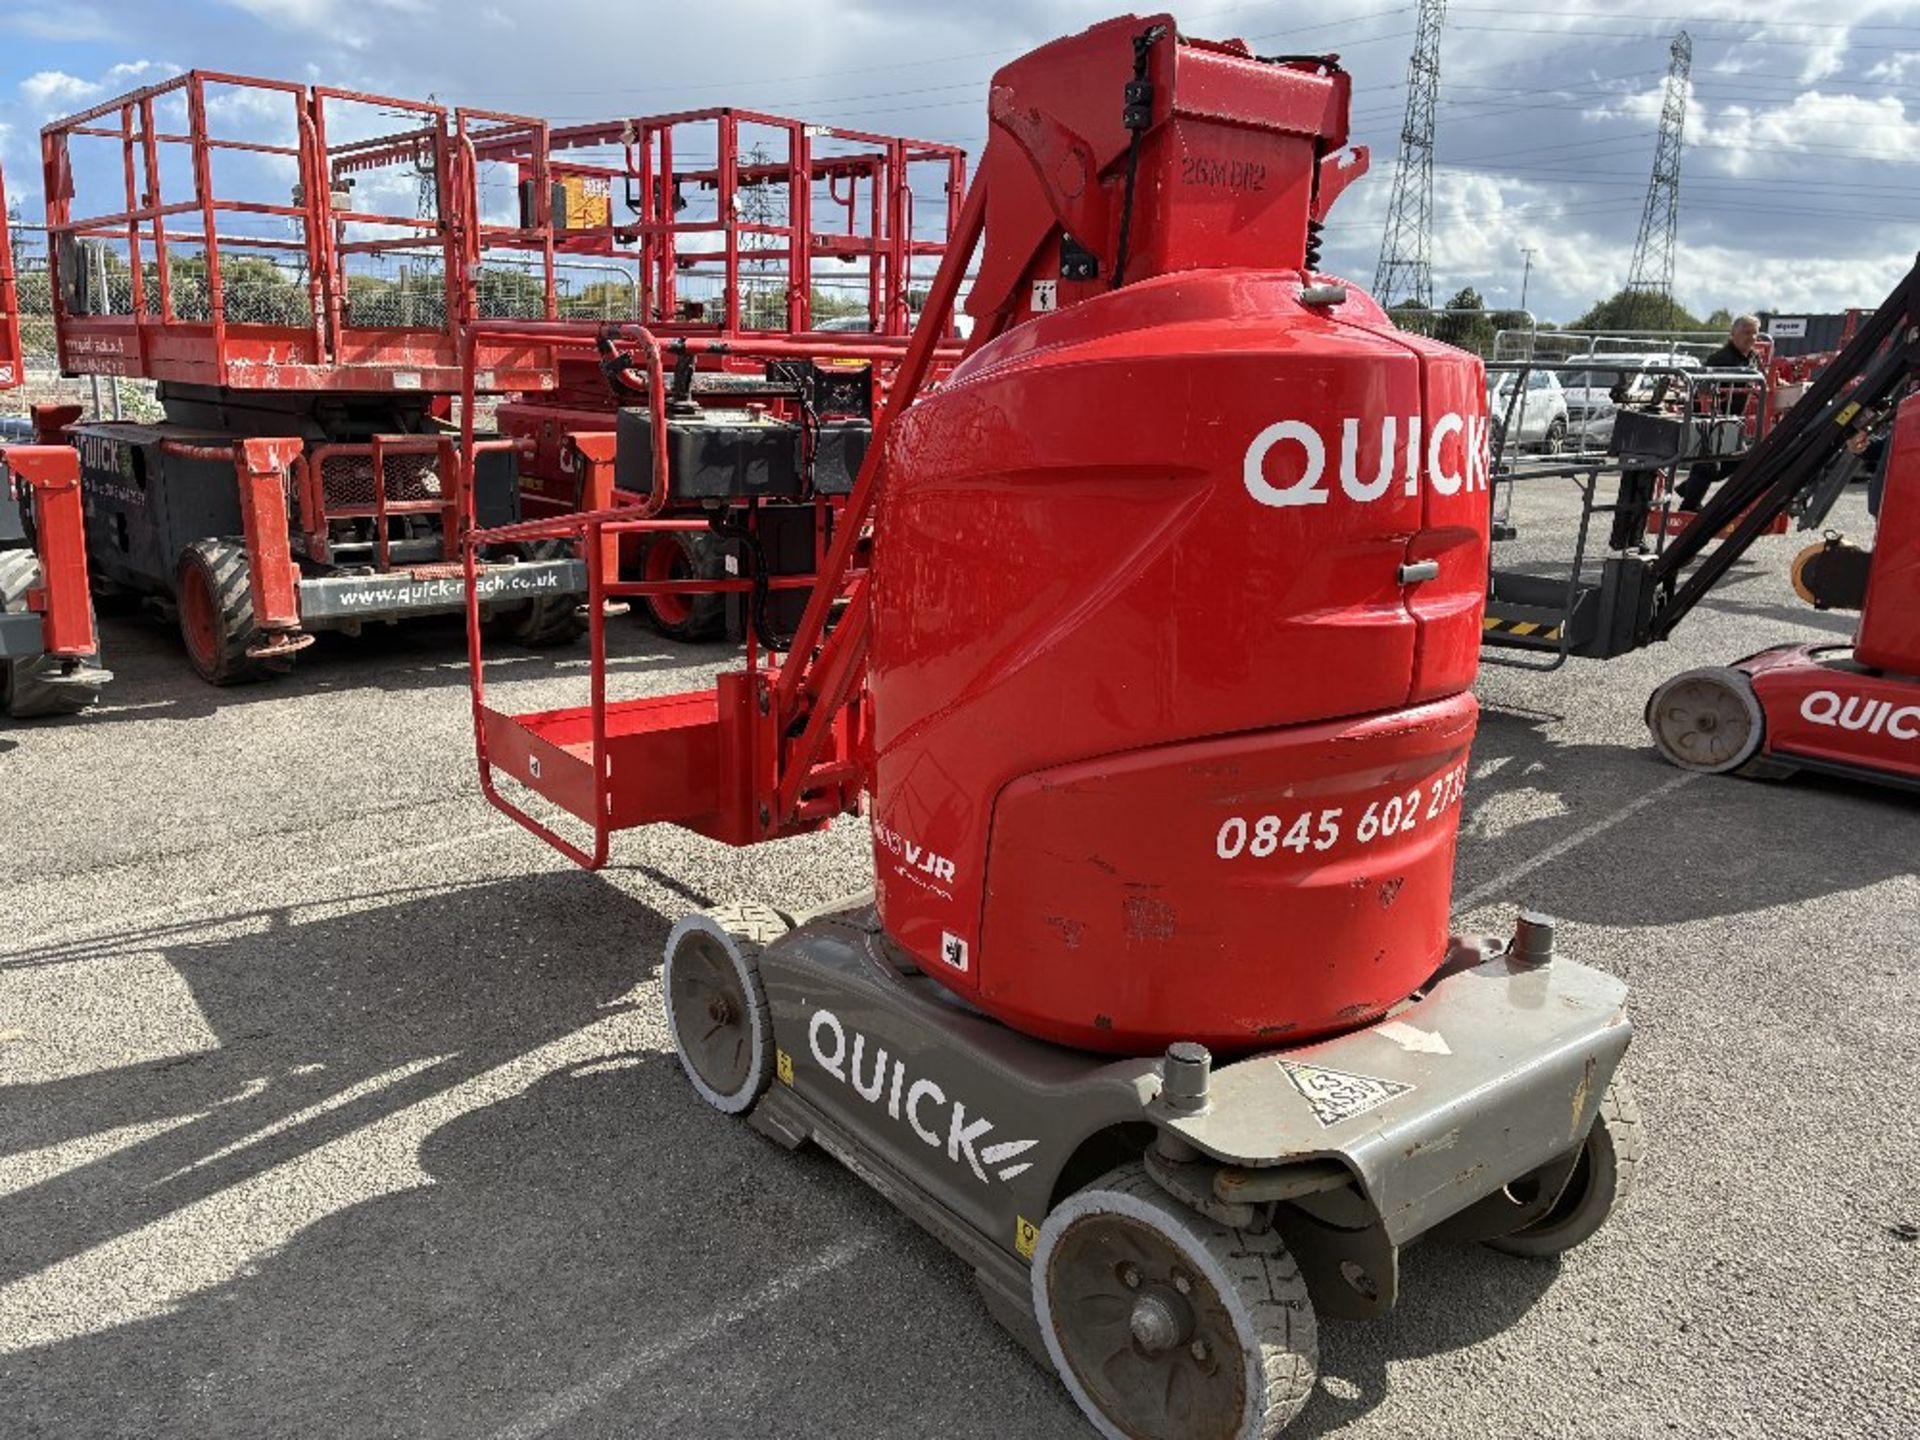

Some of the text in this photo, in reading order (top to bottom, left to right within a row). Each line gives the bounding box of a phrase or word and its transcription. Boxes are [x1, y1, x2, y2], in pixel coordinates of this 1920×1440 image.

[1244, 412, 1487, 507] QUICK
[339, 570, 558, 606] www.quick-rach.co.uk
[1801, 690, 1920, 739] QUIC
[1216, 808, 1343, 859] 0845
[1356, 789, 1421, 843] 602
[809, 1009, 994, 1183] QUICK
